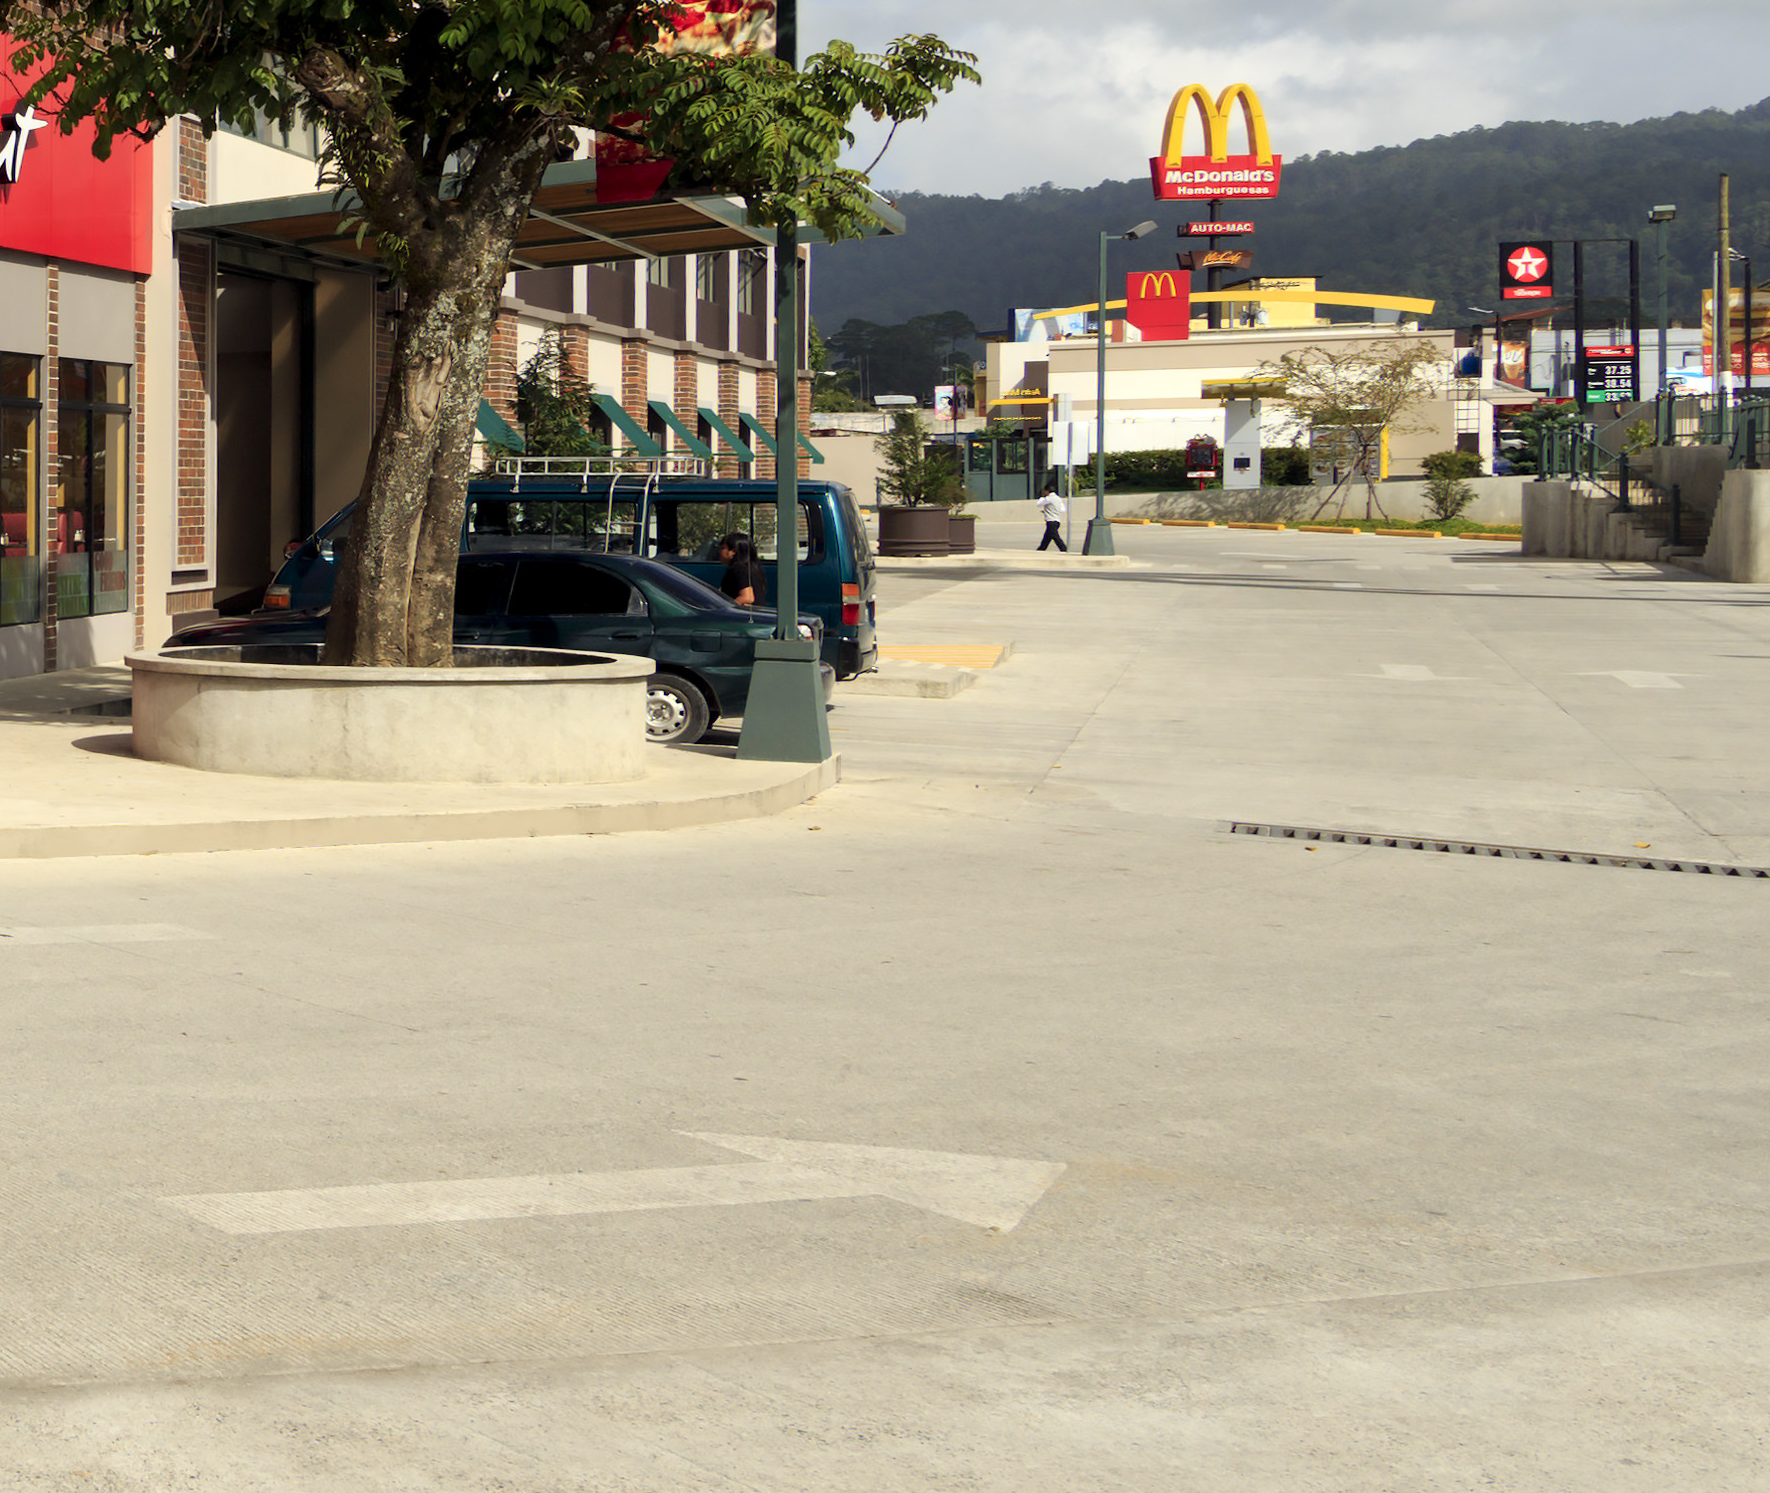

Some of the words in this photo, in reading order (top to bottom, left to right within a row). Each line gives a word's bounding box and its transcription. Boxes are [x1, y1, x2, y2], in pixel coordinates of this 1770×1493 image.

[1164, 169, 1275, 184] McDonald's
[1177, 186, 1270, 196] Hamburguesas
[1190, 223, 1253, 233] AUTO-MAC
